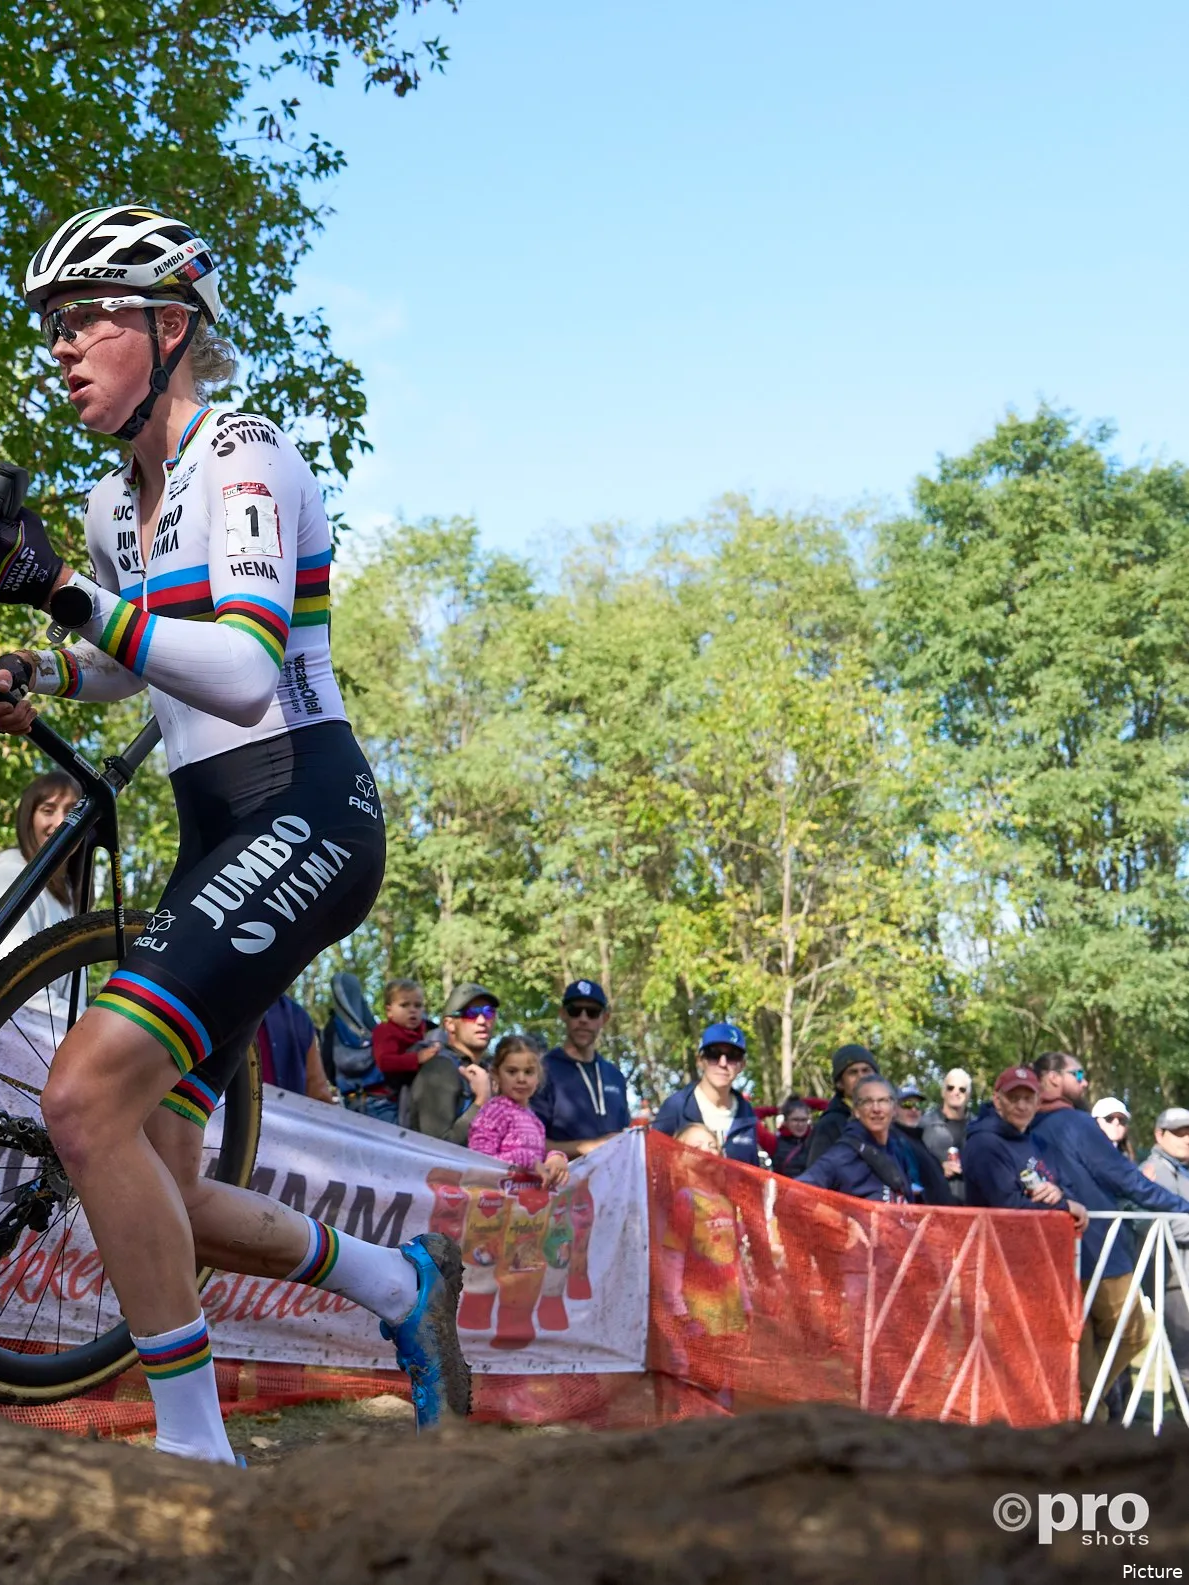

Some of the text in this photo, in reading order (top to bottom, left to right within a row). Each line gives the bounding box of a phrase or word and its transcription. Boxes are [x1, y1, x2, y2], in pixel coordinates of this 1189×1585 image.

[66, 267, 128, 279] LAZER
[153, 251, 185, 278] JUMBO
[235, 428, 280, 450] VISMA
[245, 505, 260, 537] 1
[3, 562, 23, 590] VISMA
[11, 548, 36, 591] JUMBO
[230, 561, 279, 583] HEMA
[348, 796, 378, 819] AGU
[190, 815, 312, 931] JUMBO
[263, 838, 352, 923] VISMA
[133, 936, 169, 952] AGU
